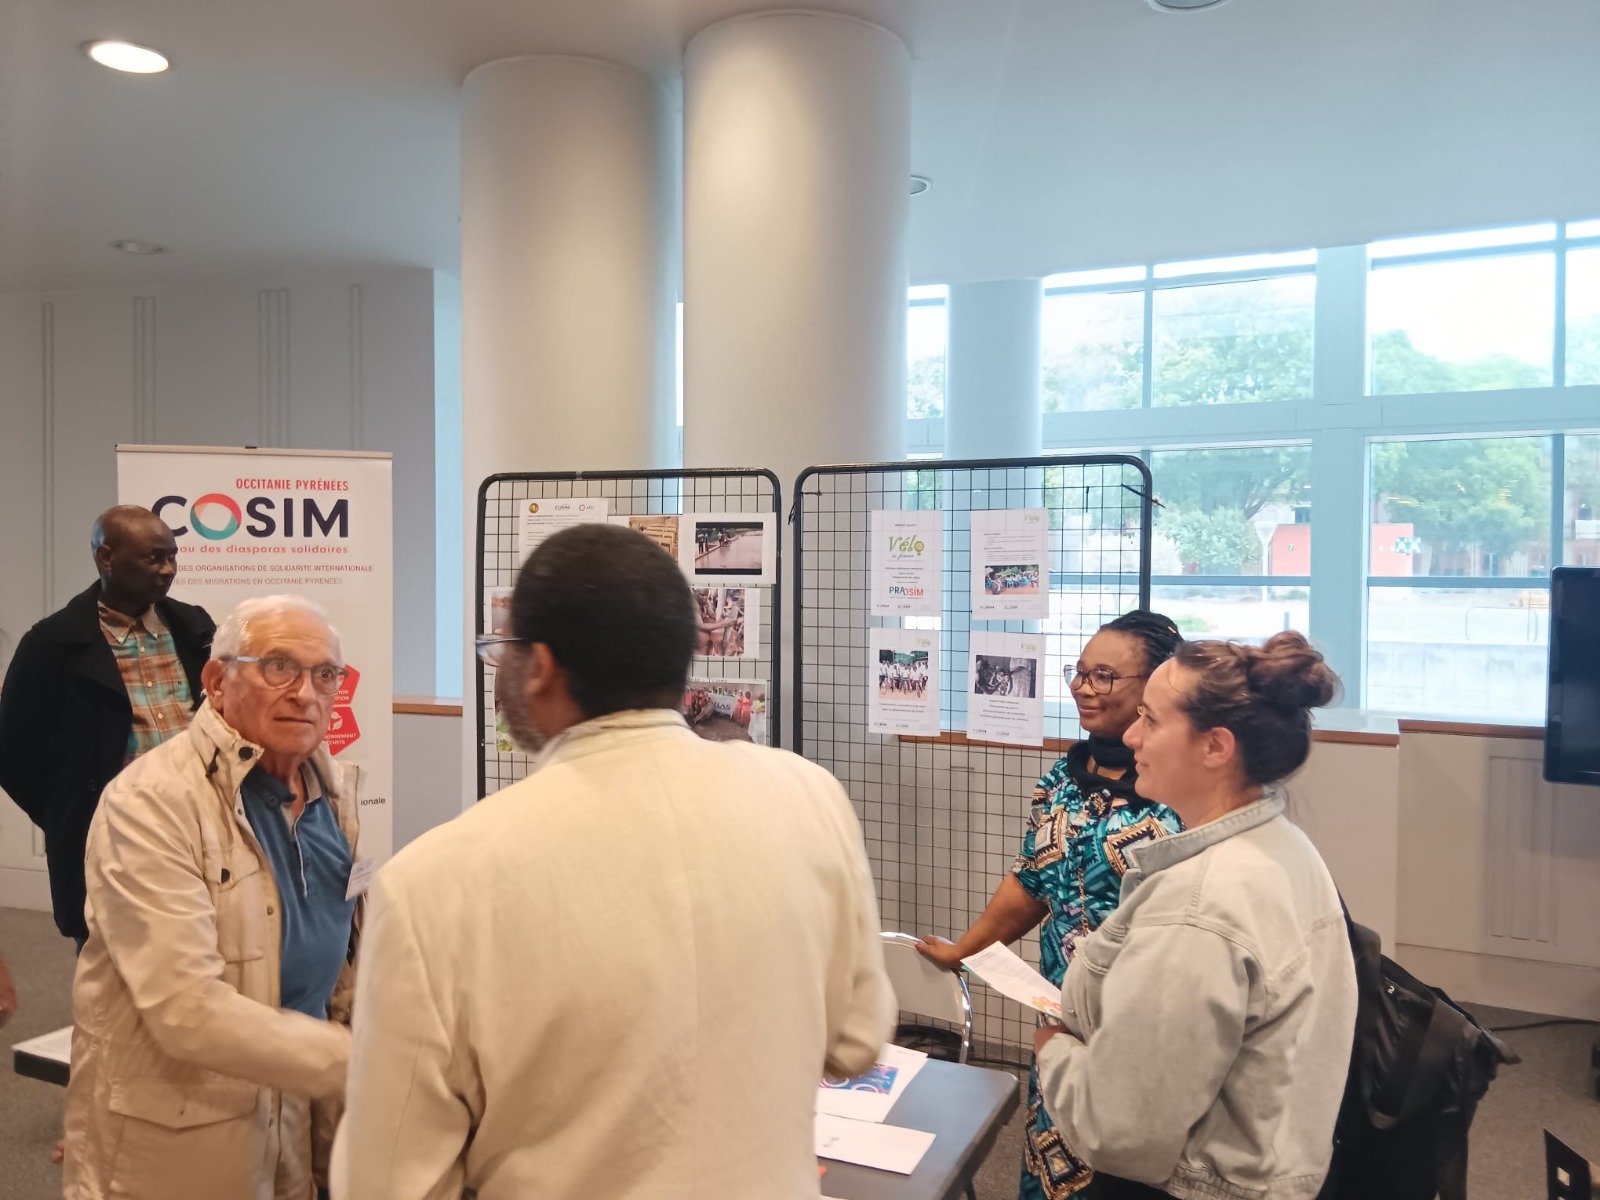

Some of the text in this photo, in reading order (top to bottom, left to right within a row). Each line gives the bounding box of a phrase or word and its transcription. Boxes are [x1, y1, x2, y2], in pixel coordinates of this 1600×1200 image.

[235, 478, 349, 491] OCCITANIE PYRÉNÉES
[151, 493, 349, 540] COSIM
[200, 544, 221, 553] des
[227, 544, 286, 555] diasporas
[291, 545, 348, 554] solidaires
[888, 535, 925, 556] Vélo
[360, 797, 386, 806] ionale
